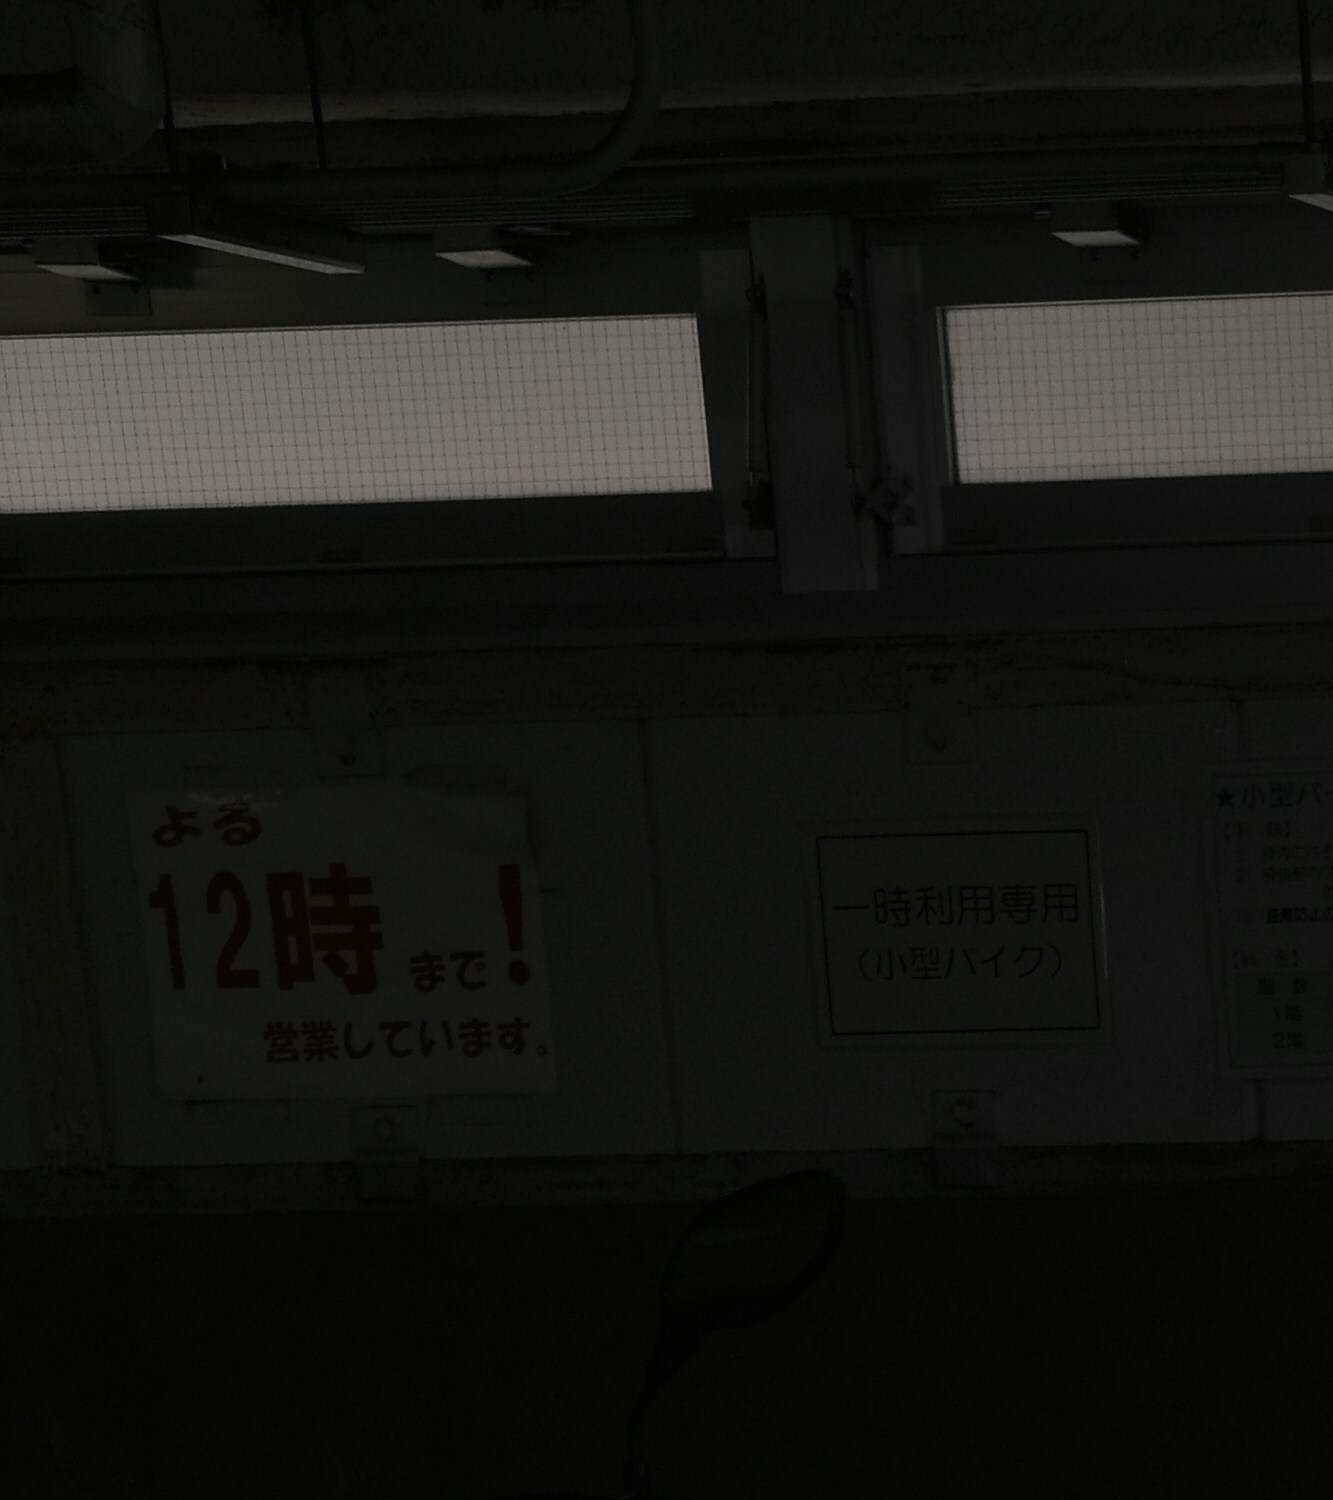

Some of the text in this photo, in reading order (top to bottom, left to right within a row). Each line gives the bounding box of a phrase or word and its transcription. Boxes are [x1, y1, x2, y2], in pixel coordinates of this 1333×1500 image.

[151, 804, 261, 847] よる
[832, 882, 1079, 927] 一時利用専用
[262, 1018, 548, 1064] 営業しています。
